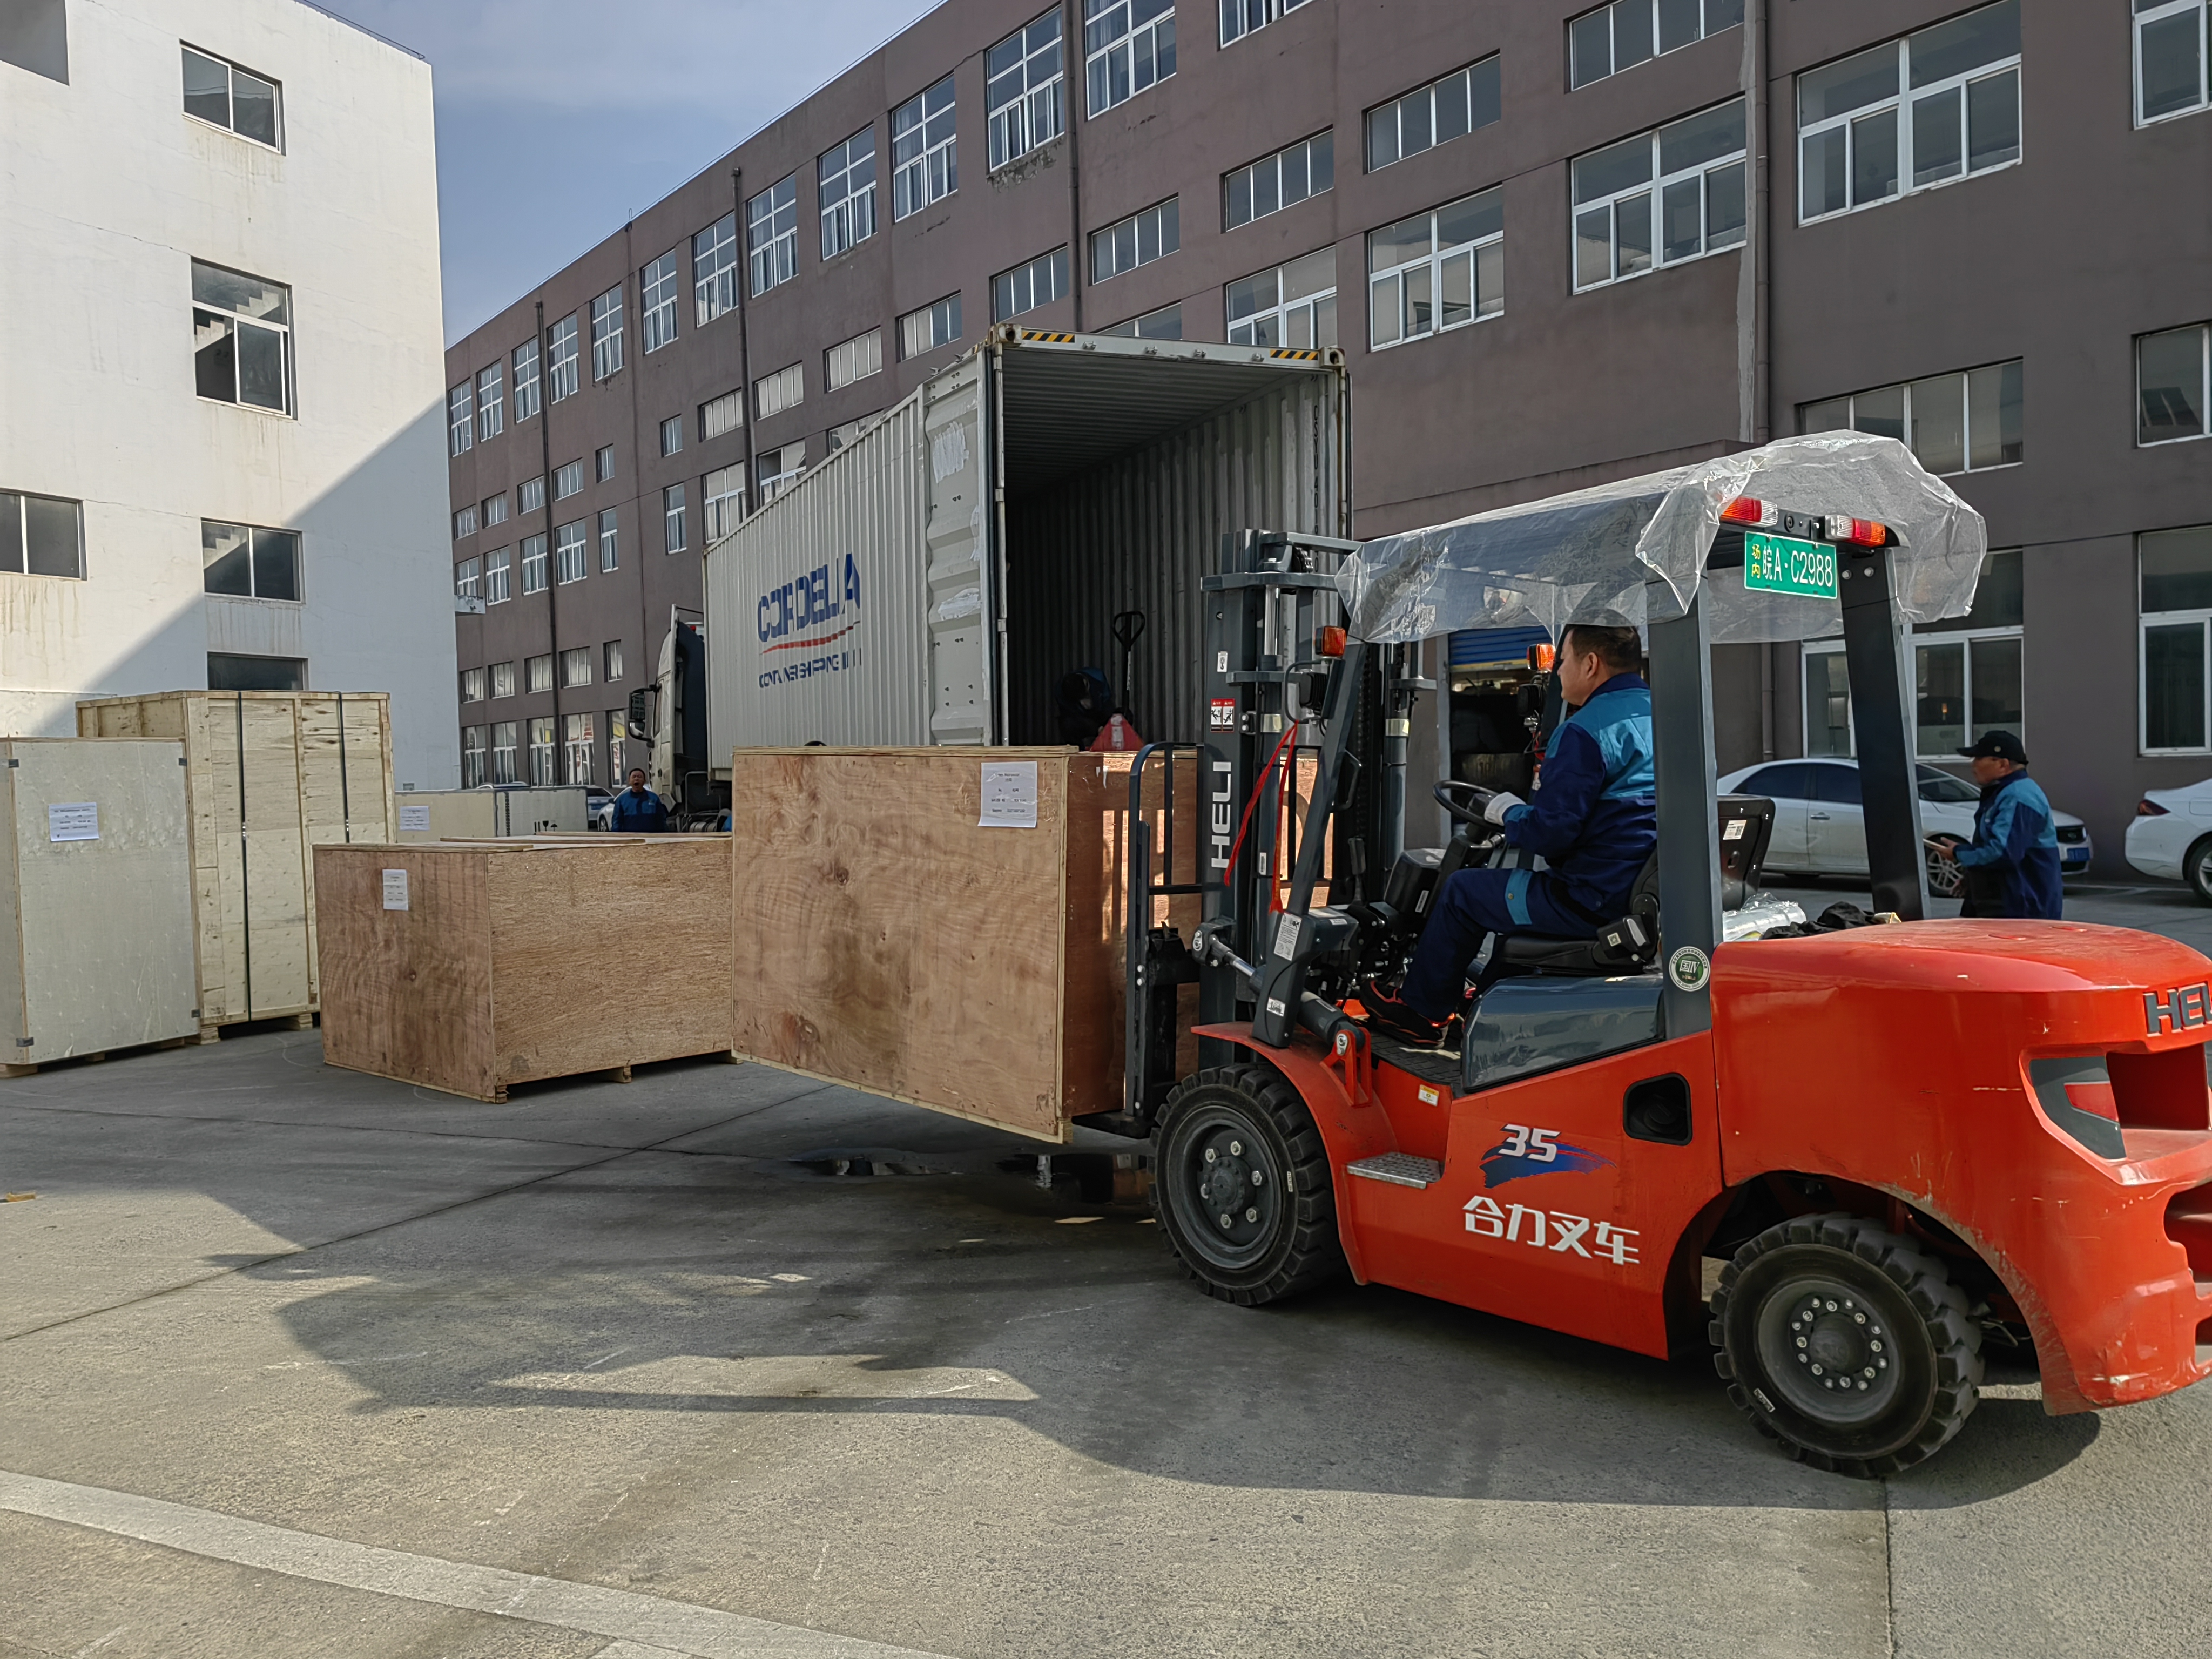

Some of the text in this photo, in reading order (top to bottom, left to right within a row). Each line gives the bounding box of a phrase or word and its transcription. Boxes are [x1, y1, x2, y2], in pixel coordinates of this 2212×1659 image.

[1751, 544, 1761, 579] 场内
[1211, 761, 1231, 868] HELI
[1498, 1123, 1561, 1163] 35
[1462, 1195, 1640, 1265] 合力叉车
